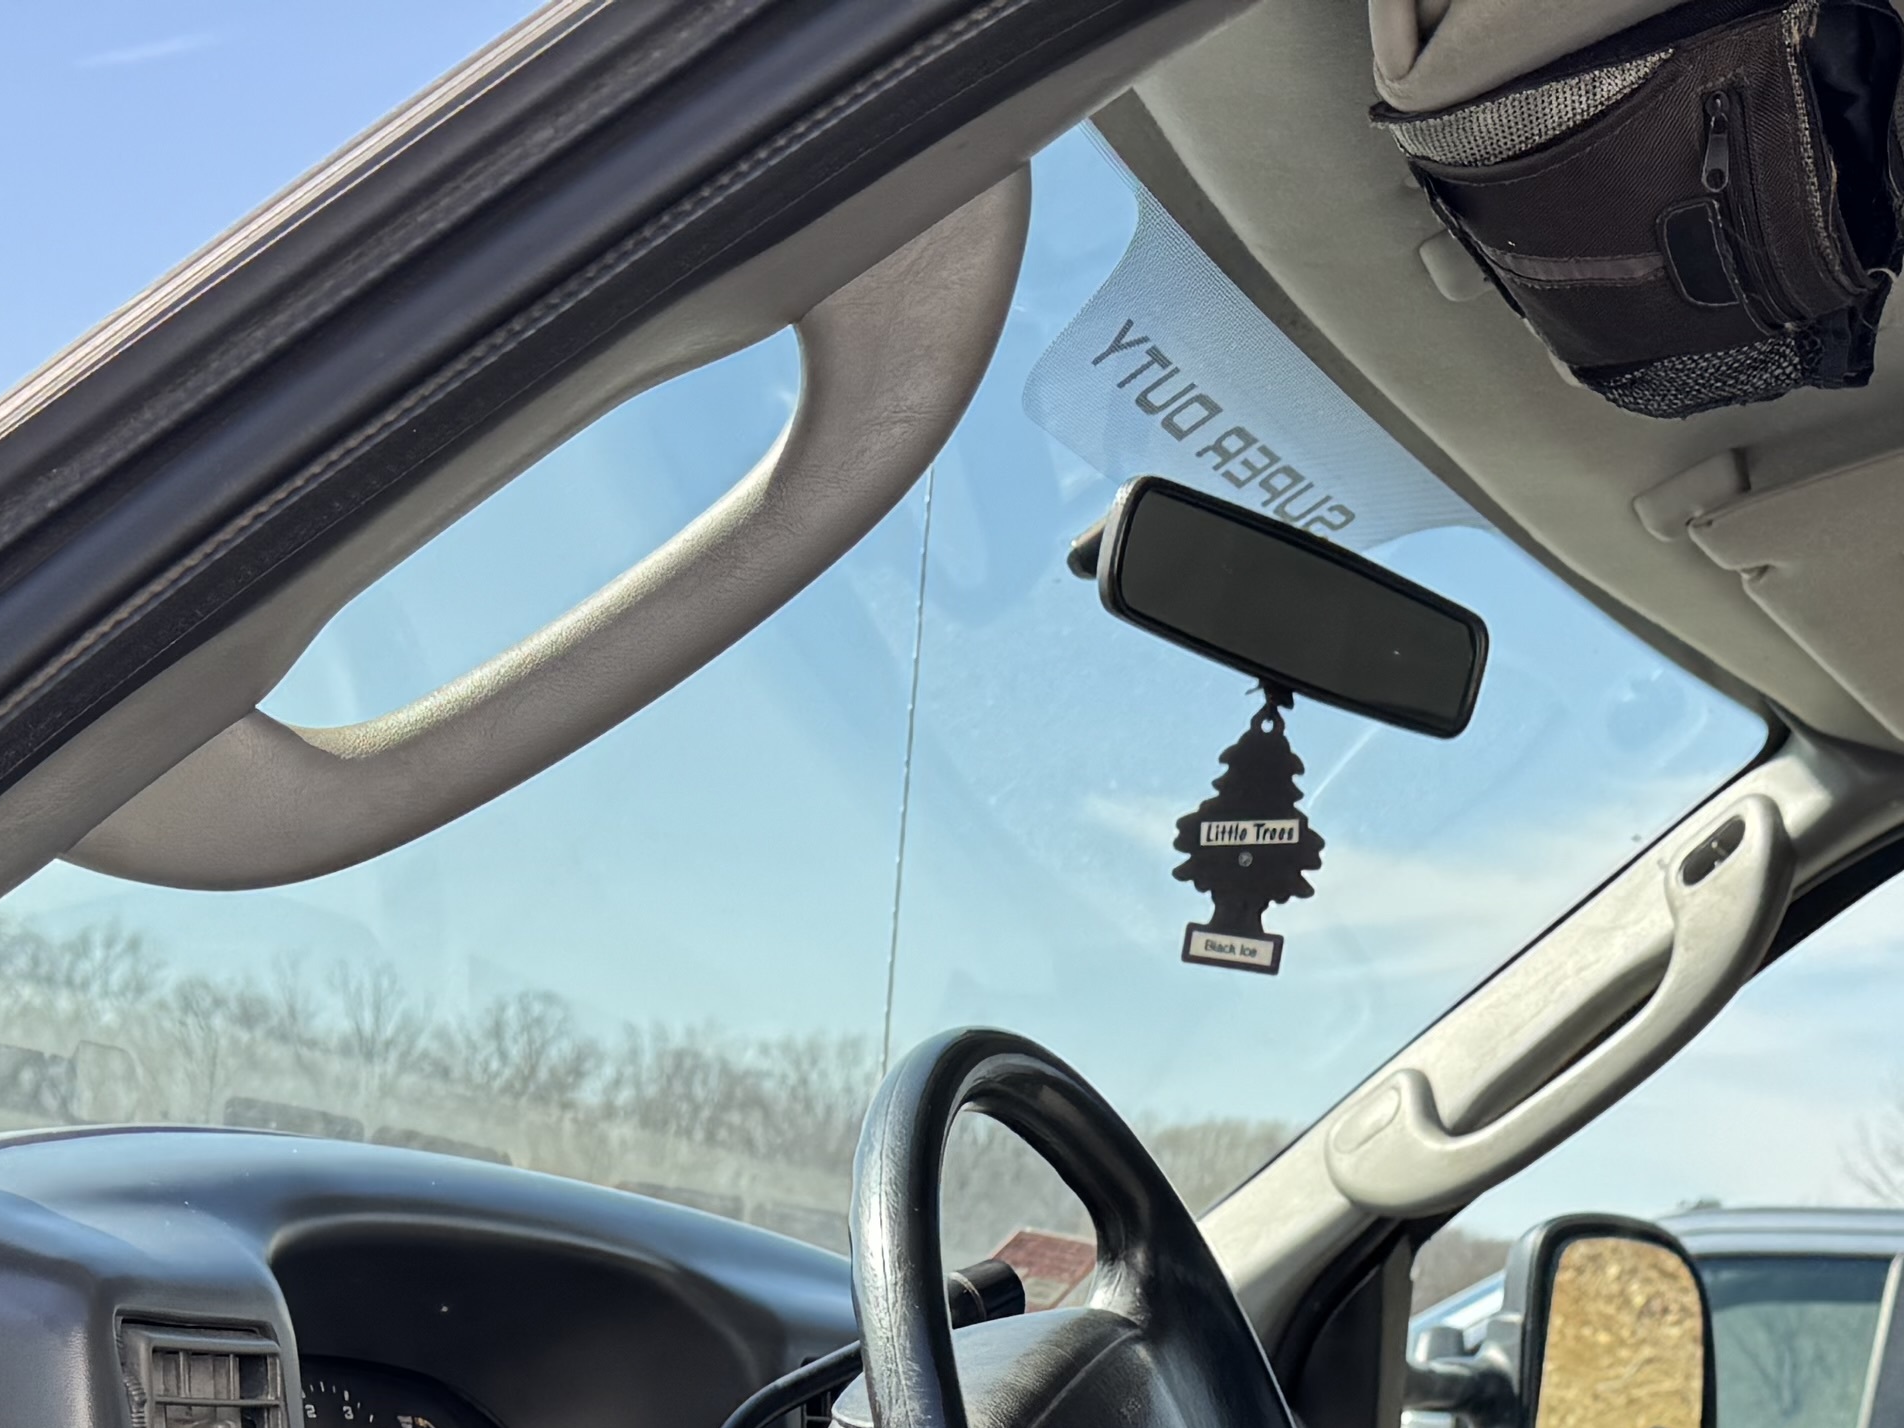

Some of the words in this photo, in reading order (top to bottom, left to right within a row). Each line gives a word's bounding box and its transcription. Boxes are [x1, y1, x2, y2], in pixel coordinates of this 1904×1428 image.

[1206, 823, 1248, 843] Little
[1253, 822, 1295, 842] Trees
[1204, 938, 1236, 956] Black
[1240, 945, 1258, 958] Ice
[304, 1404, 317, 1419] 2
[342, 1405, 354, 1420] 3
